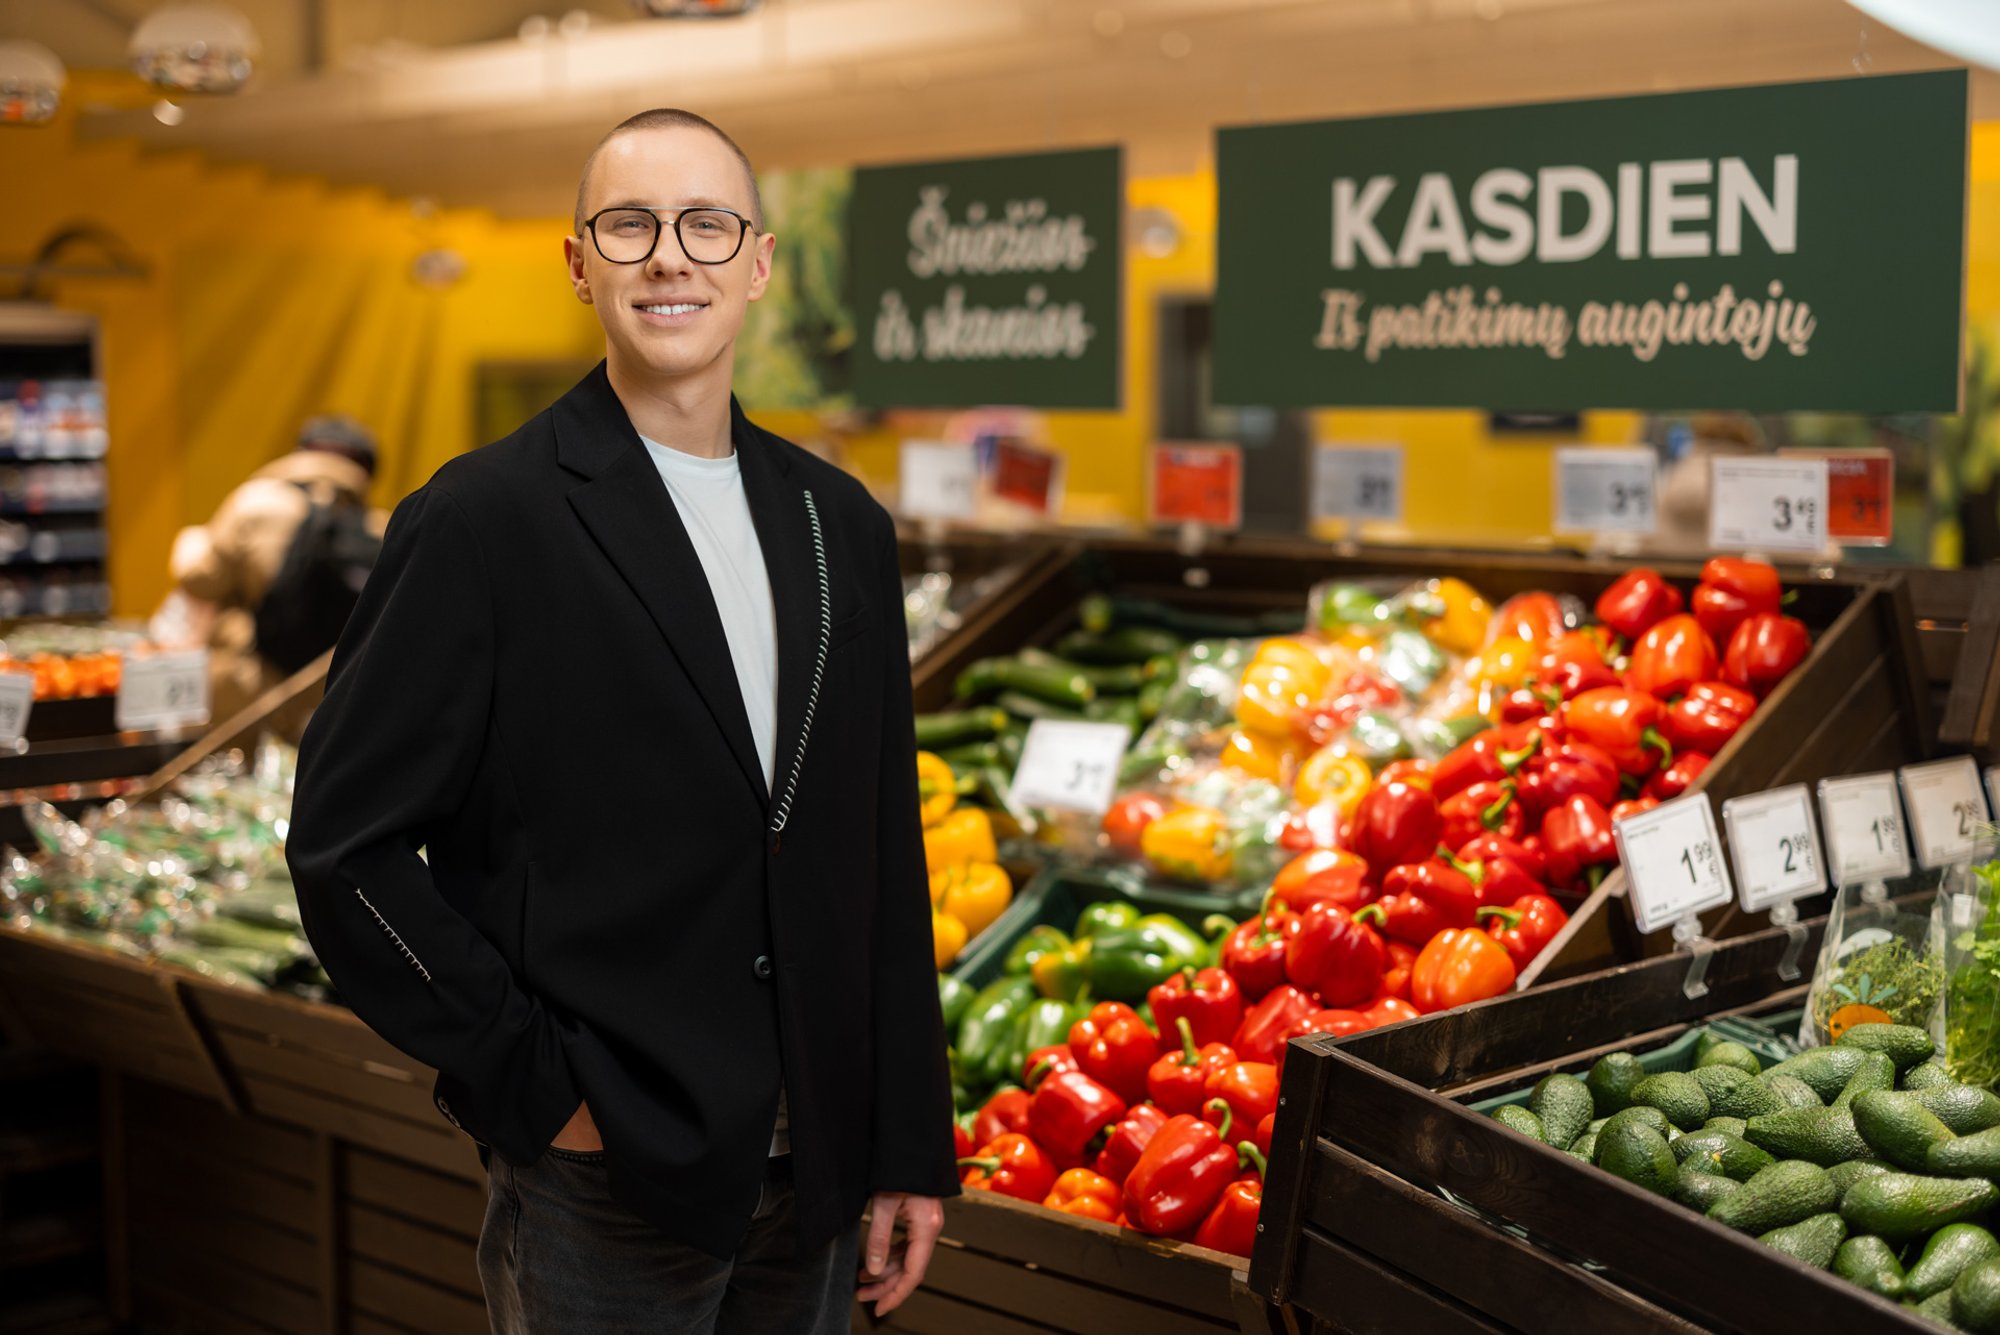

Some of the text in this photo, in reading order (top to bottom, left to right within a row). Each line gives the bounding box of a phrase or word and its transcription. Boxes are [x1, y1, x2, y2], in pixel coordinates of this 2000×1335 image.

[1331, 154, 1799, 270] KASDIEN
[1313, 279, 1817, 362] Iš patikimų augintojų
